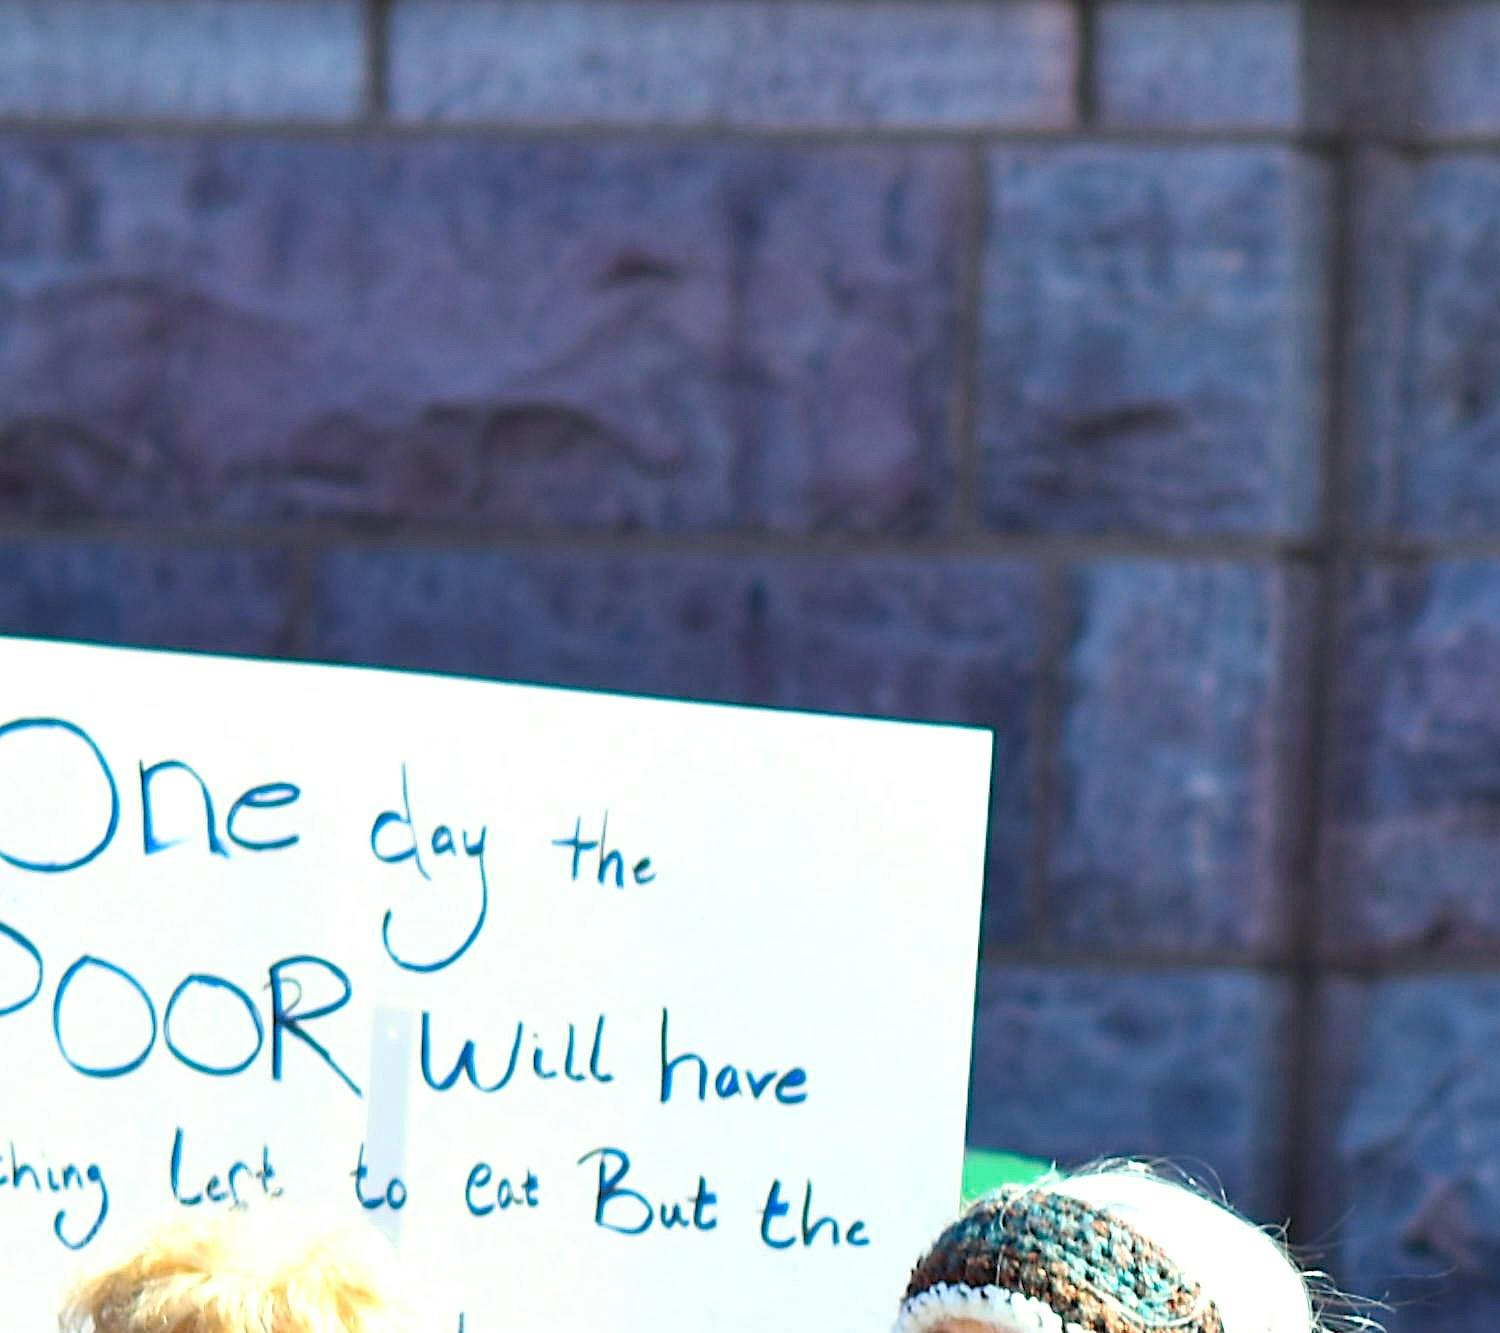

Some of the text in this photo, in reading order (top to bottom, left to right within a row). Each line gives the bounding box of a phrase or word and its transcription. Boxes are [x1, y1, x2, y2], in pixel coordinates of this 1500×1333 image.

[0, 717, 657, 972] One day the
[420, 1009, 614, 1093] Will
[661, 1007, 809, 1105] have
[350, 1142, 408, 1210] to
[464, 1157, 540, 1217] eat
[578, 1147, 717, 1237] But
[759, 1179, 871, 1251] the
